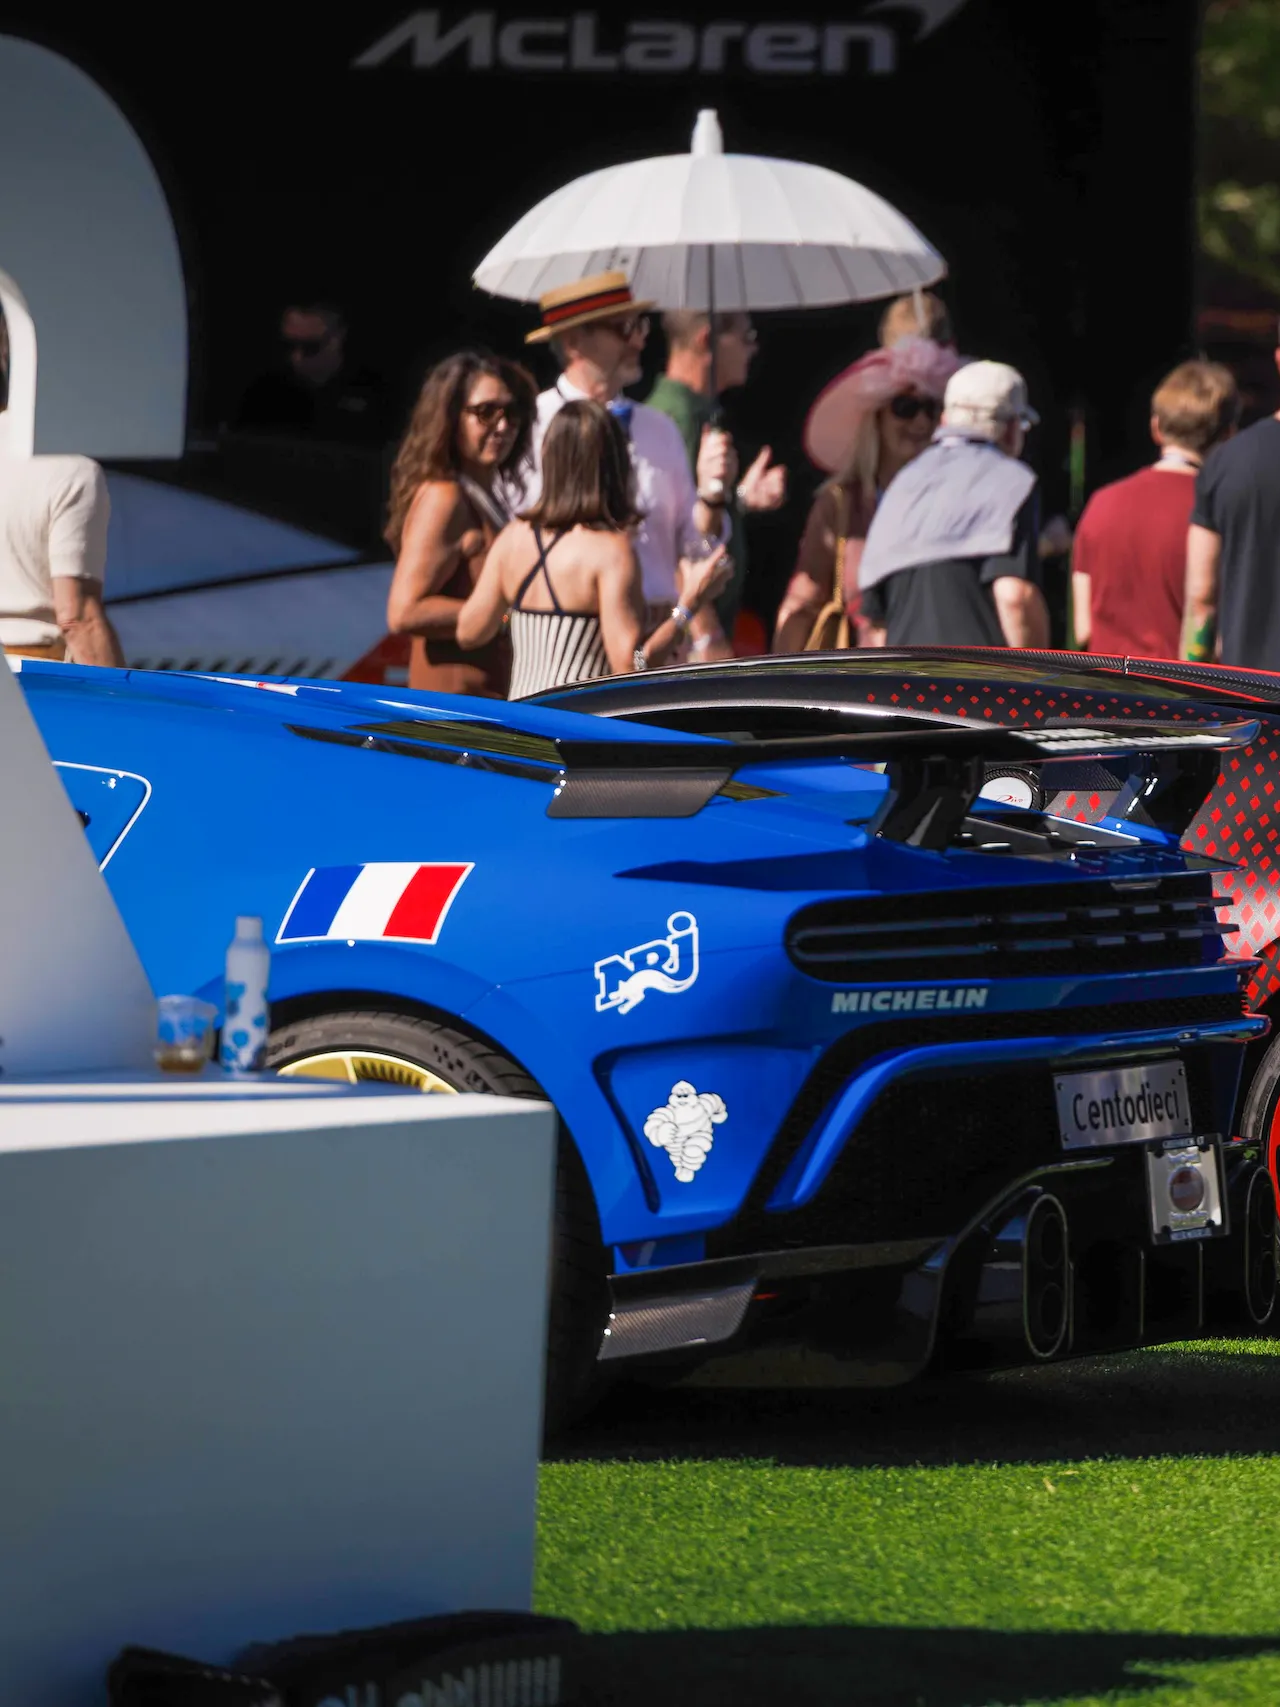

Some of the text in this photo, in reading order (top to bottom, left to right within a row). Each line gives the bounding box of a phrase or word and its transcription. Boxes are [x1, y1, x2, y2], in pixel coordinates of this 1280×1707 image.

[353, 9, 897, 74] McLaren
[831, 988, 989, 1013] MICHELIN
[1072, 1080, 1181, 1132] Centodieci
